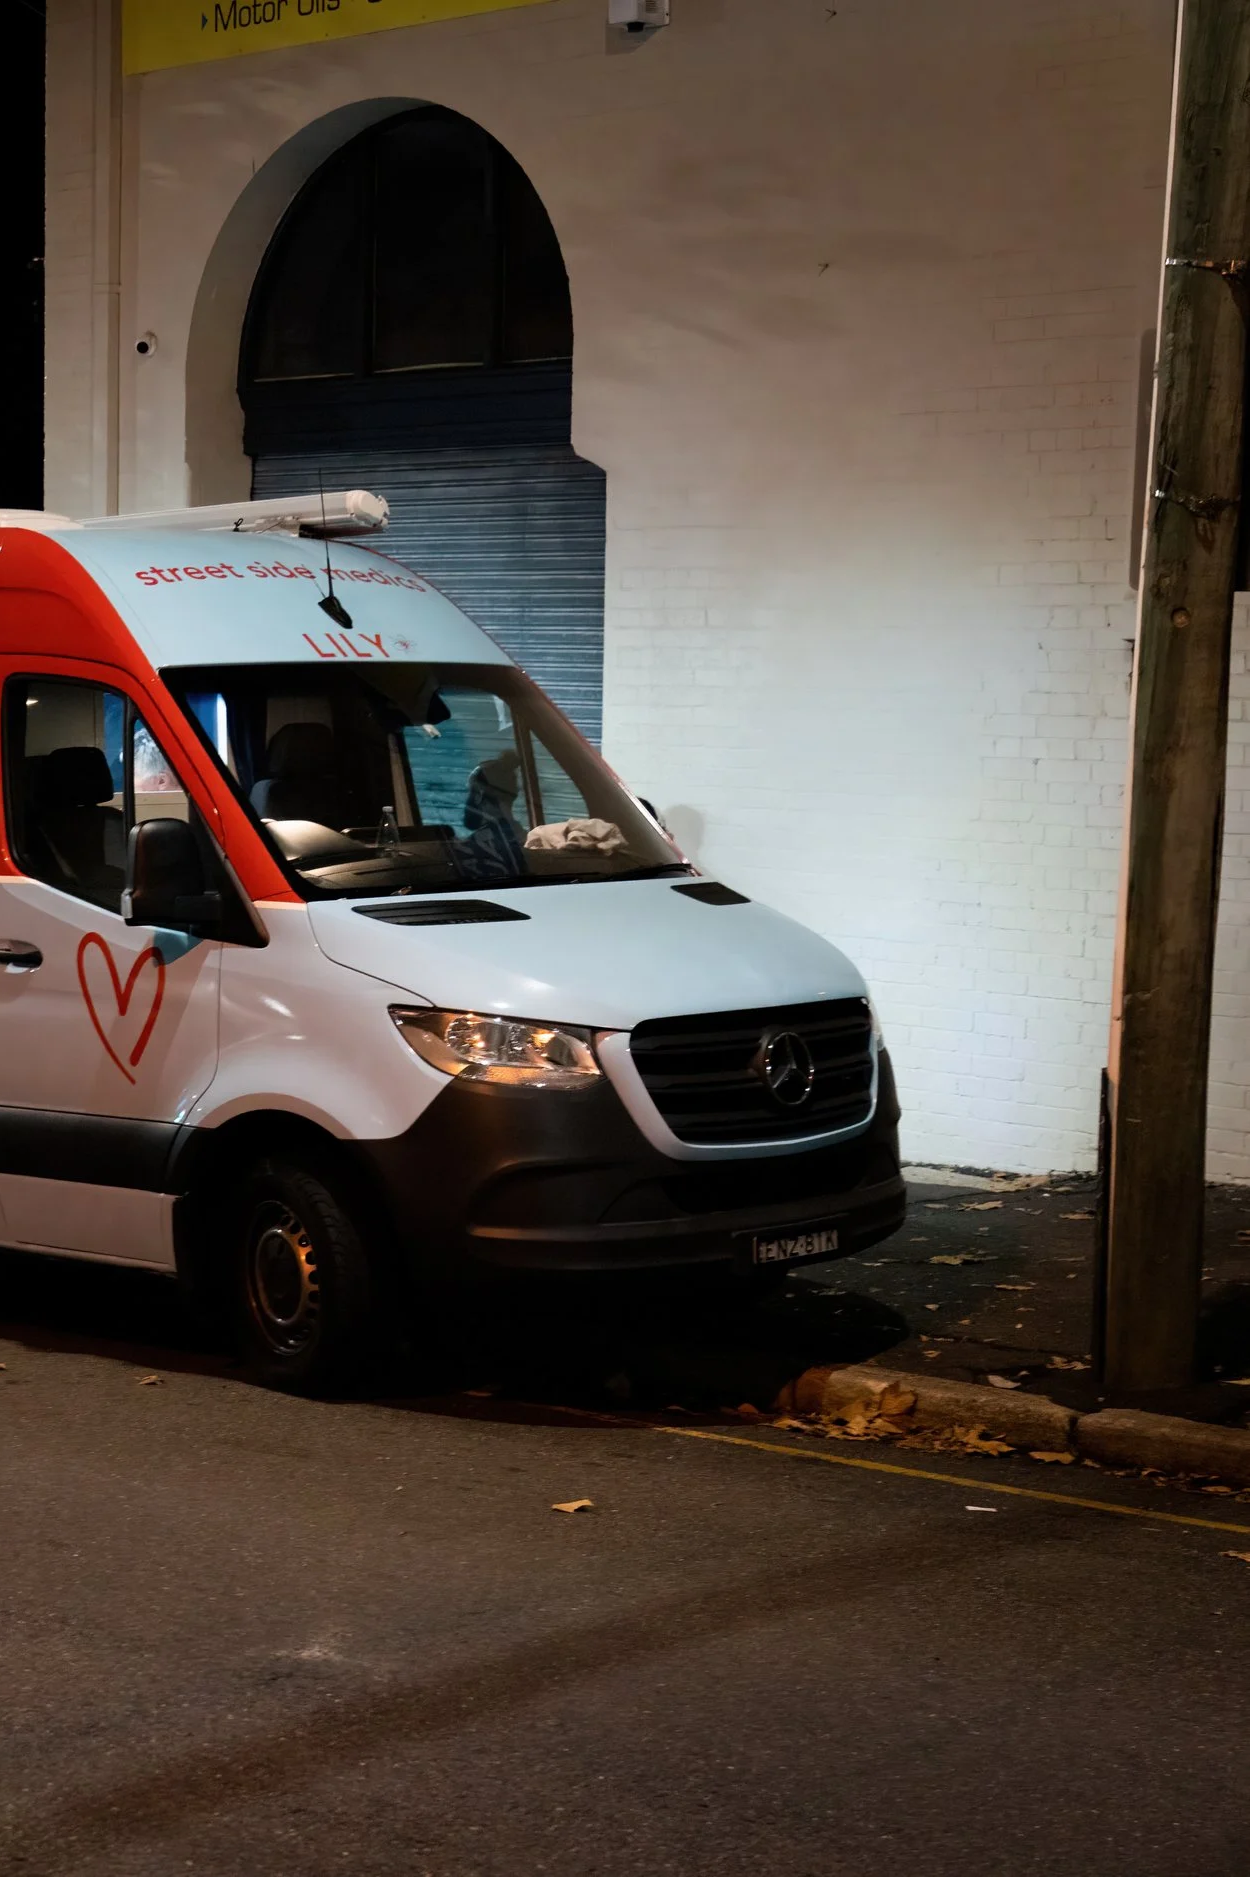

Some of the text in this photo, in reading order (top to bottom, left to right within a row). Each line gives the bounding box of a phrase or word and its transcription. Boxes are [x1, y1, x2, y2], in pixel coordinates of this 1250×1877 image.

[214, 0, 289, 33] Motor
[135, 561, 427, 593] street side medics
[302, 633, 391, 658] LILY
